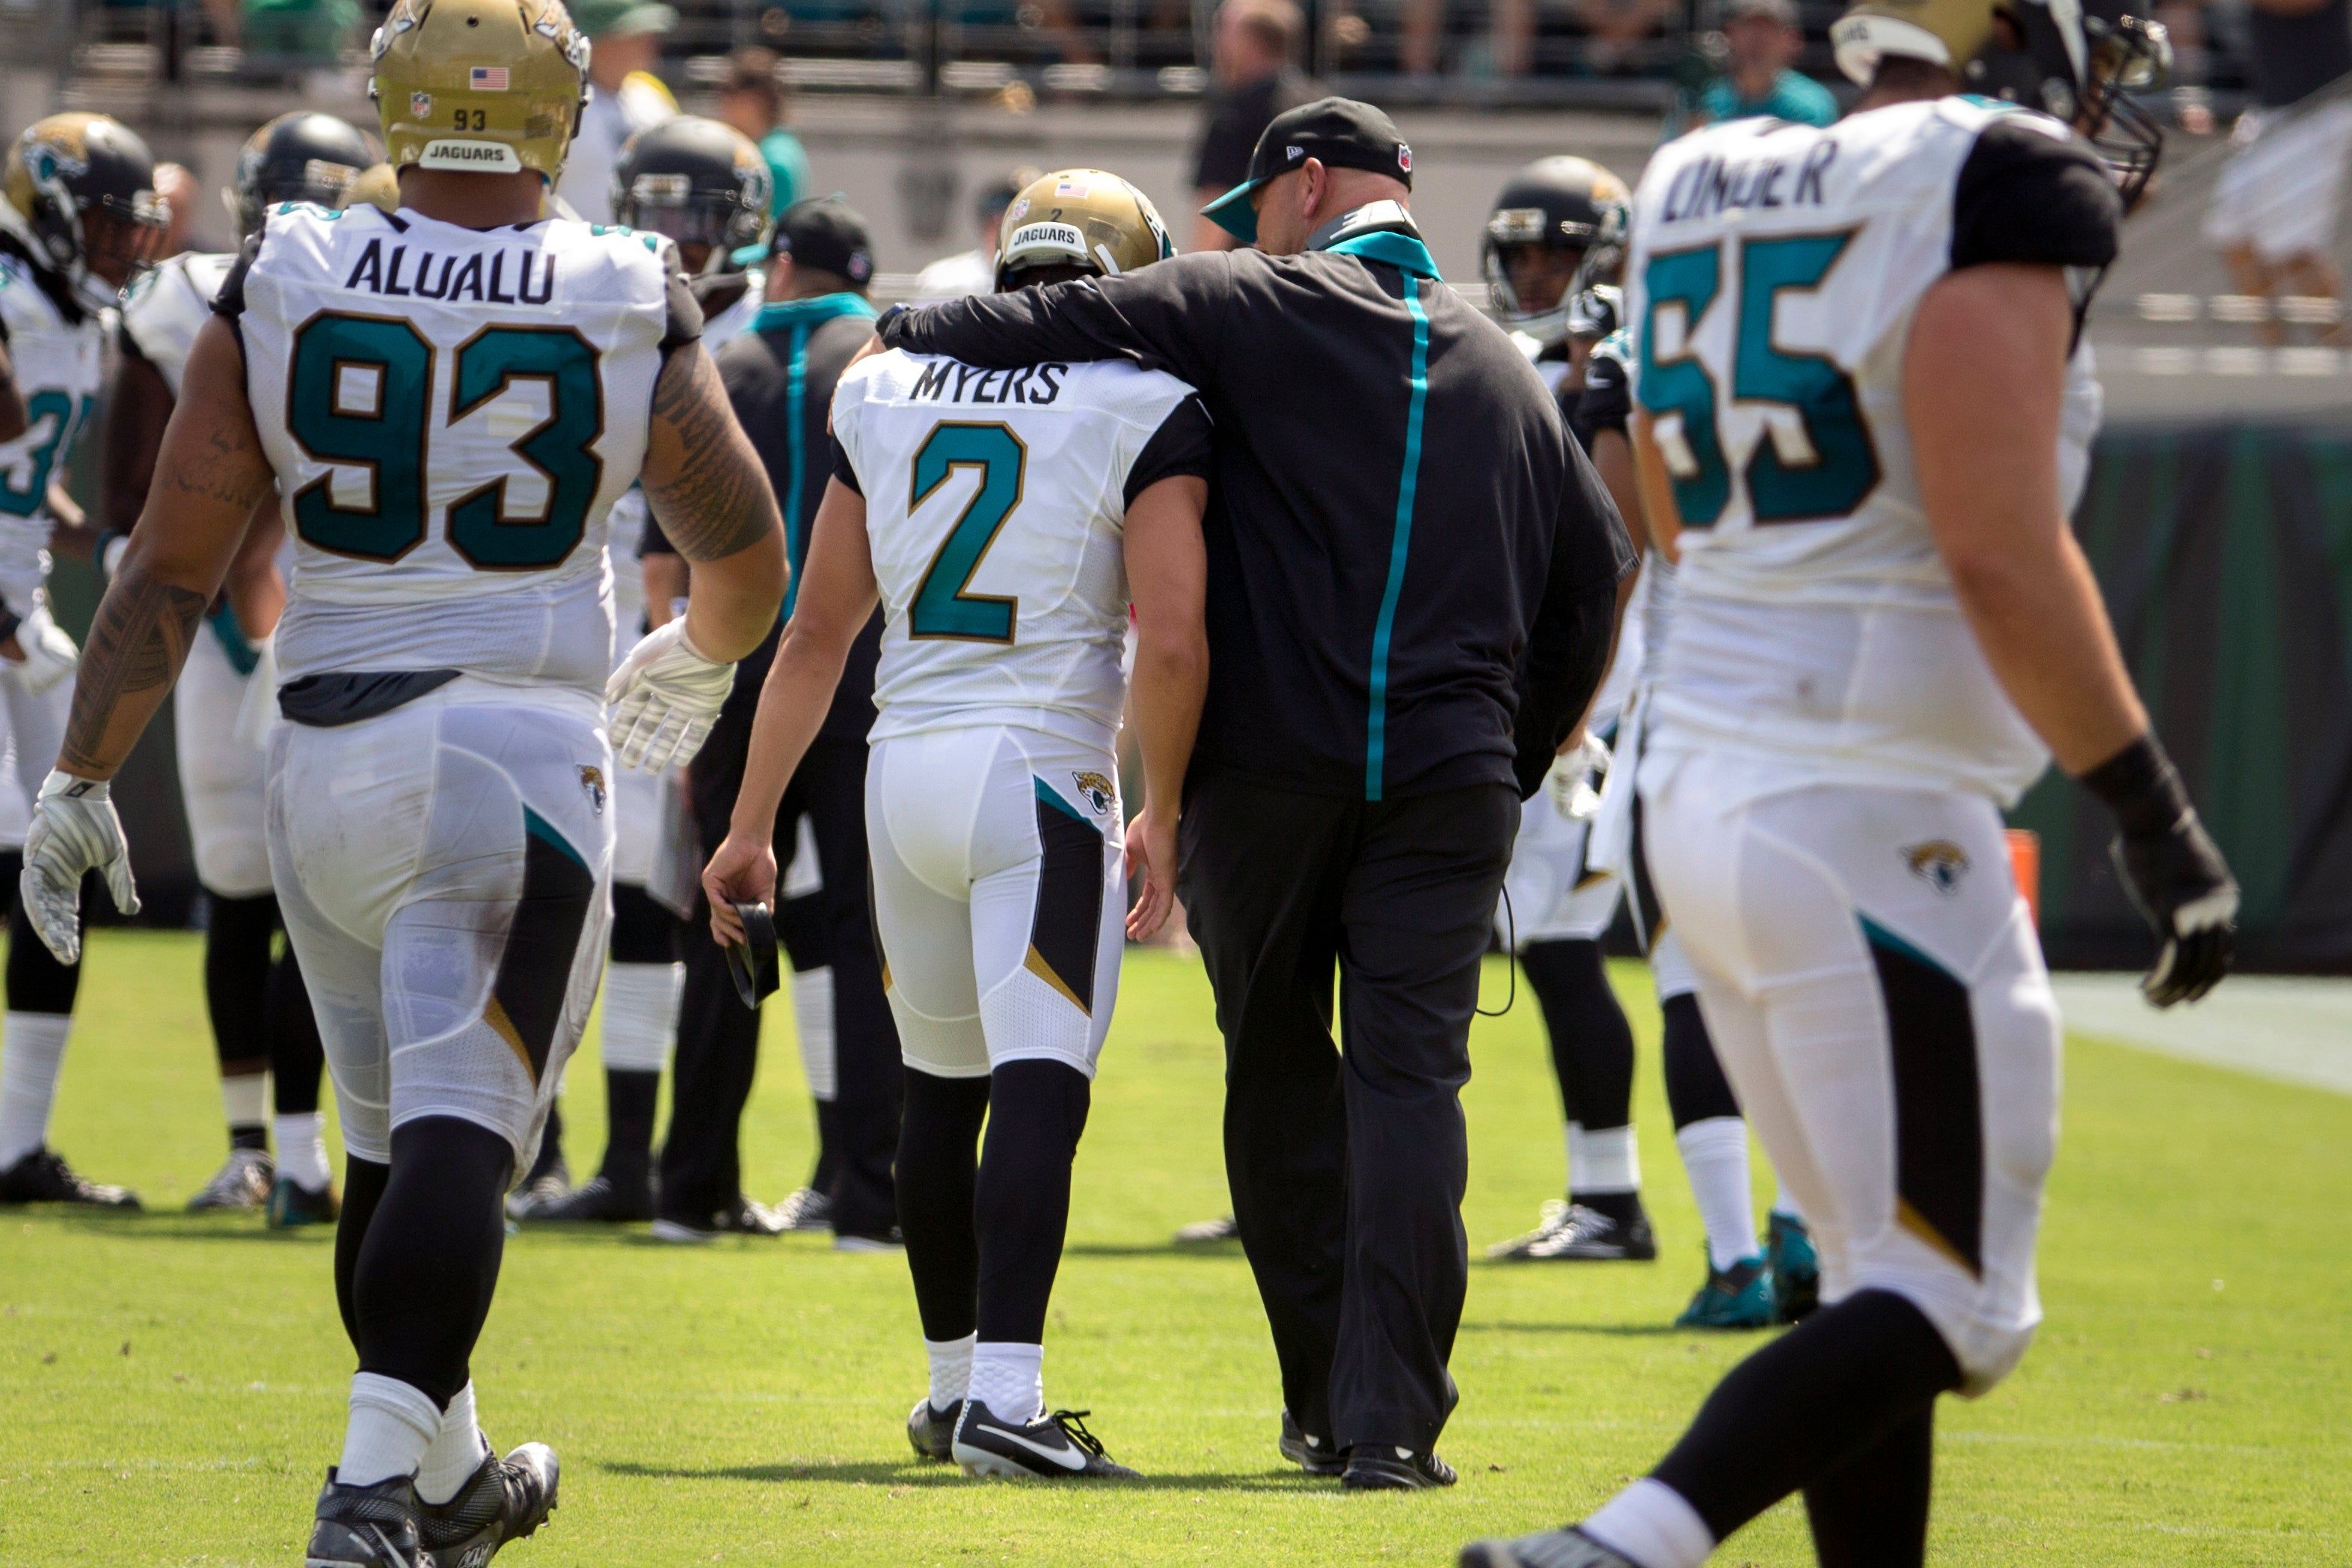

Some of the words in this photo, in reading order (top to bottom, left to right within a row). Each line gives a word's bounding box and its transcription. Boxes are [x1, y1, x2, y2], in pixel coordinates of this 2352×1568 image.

[453, 108, 486, 132] 93
[430, 145, 505, 162] JAGUARS
[1049, 207, 1063, 223] 2
[1013, 227, 1075, 247] JAGUARS
[345, 237, 556, 305] ALUALU
[909, 359, 1069, 405] MYERS
[286, 307, 606, 572] 93
[906, 419, 1029, 646] 2
